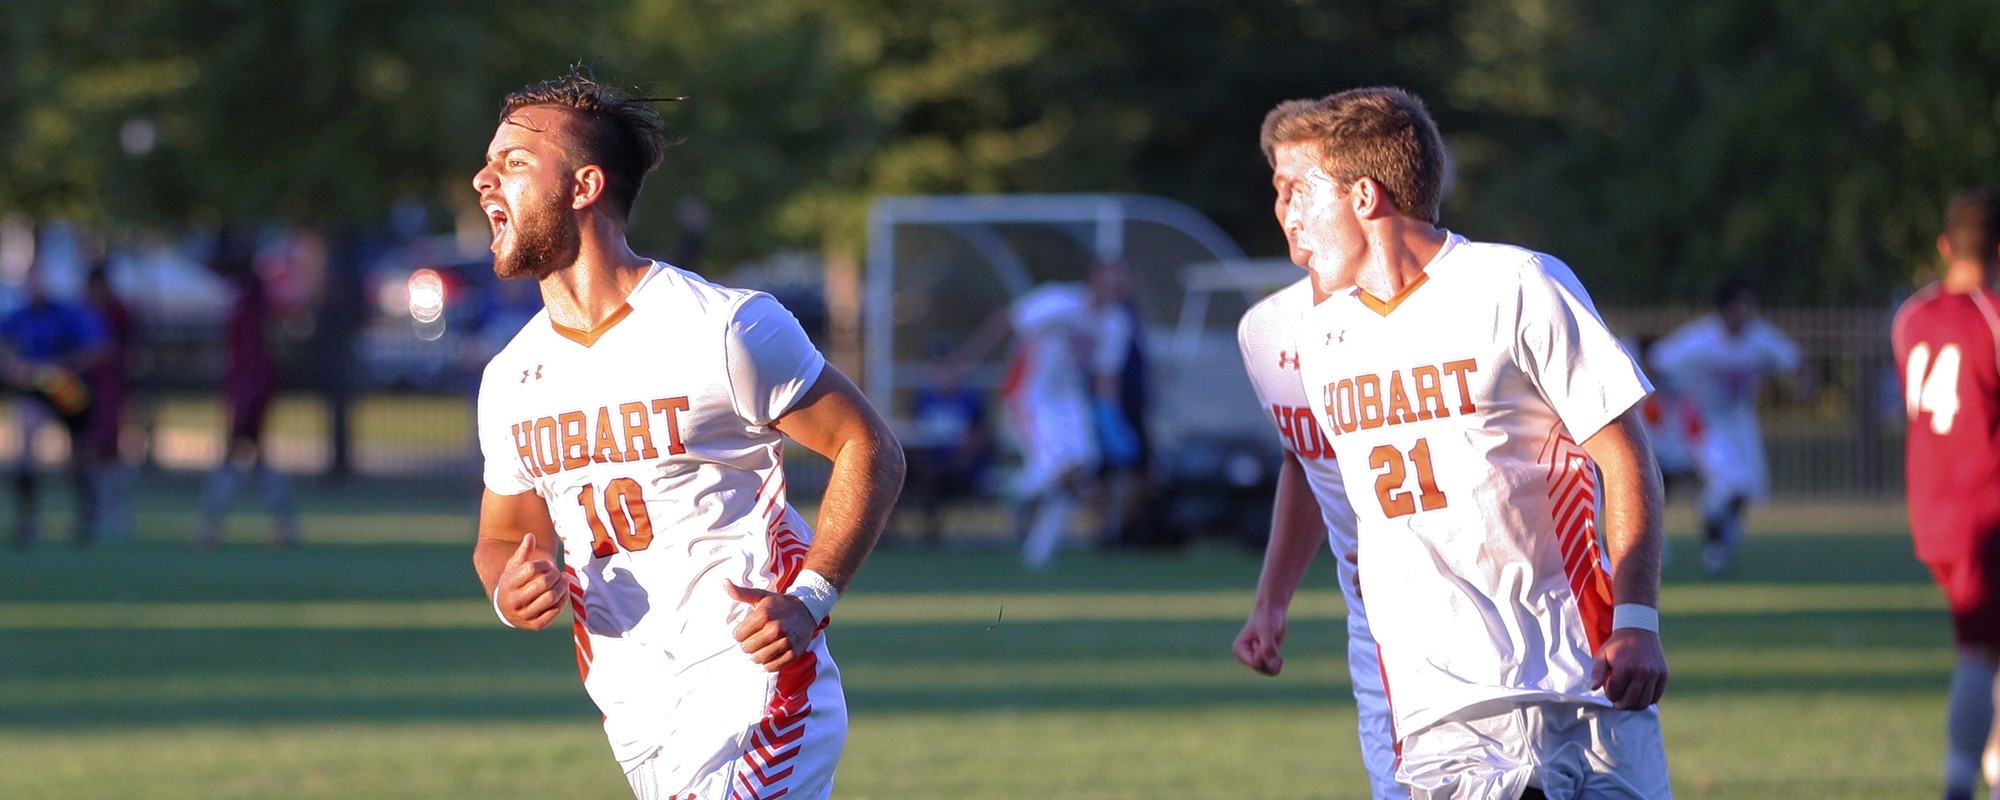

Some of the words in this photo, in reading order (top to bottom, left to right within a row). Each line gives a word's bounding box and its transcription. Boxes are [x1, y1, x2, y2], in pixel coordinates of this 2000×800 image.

[1324, 358, 1477, 436] HOBART
[1905, 340, 1961, 435] 14
[511, 395, 690, 478] HOBART
[1272, 403, 1337, 459] HO
[578, 477, 654, 559] 10
[1368, 437, 1447, 519] 21
